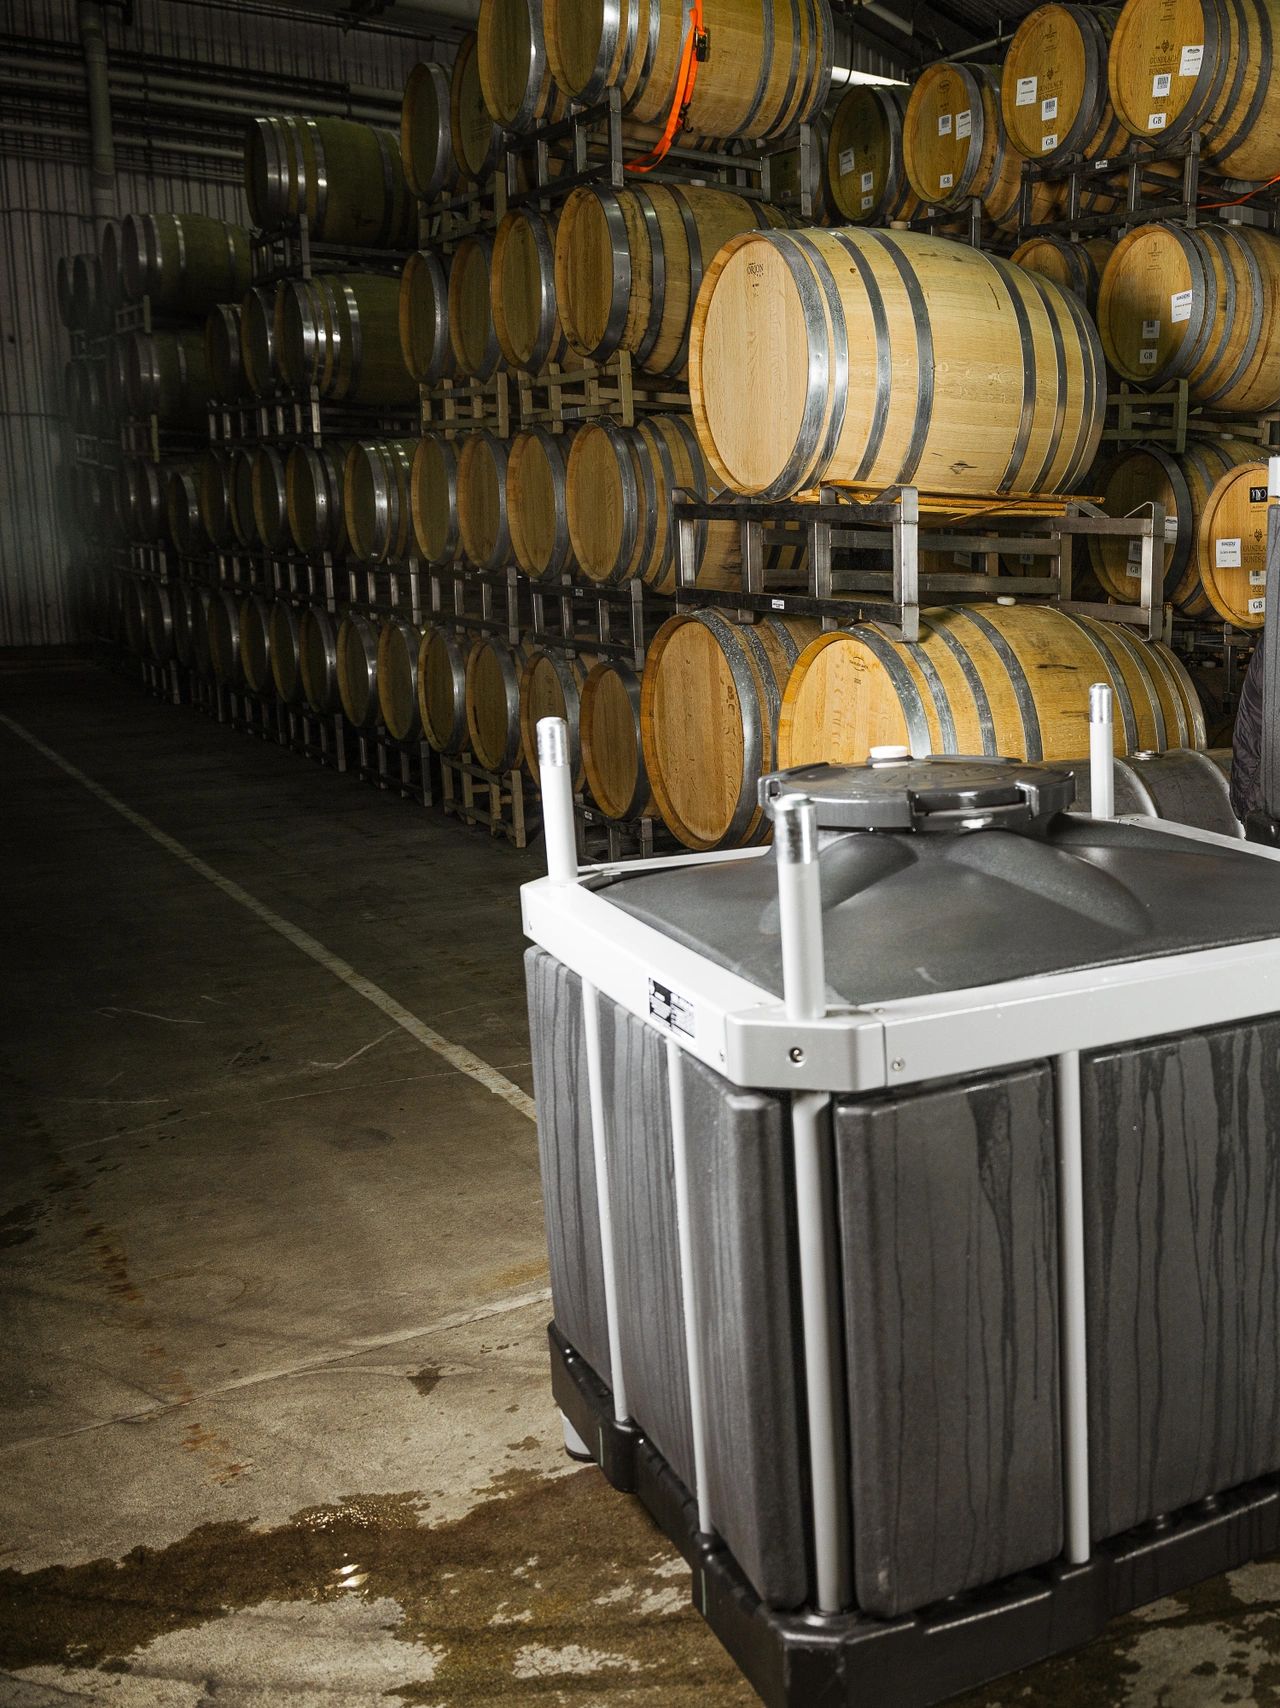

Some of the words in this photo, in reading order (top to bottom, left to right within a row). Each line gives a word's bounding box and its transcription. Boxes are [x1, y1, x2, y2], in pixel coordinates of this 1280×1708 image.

[1152, 116, 1162, 125] GB
[1045, 137, 1054, 146] GB
[1143, 351, 1153, 361] GB
[1252, 600, 1263, 610] GB
